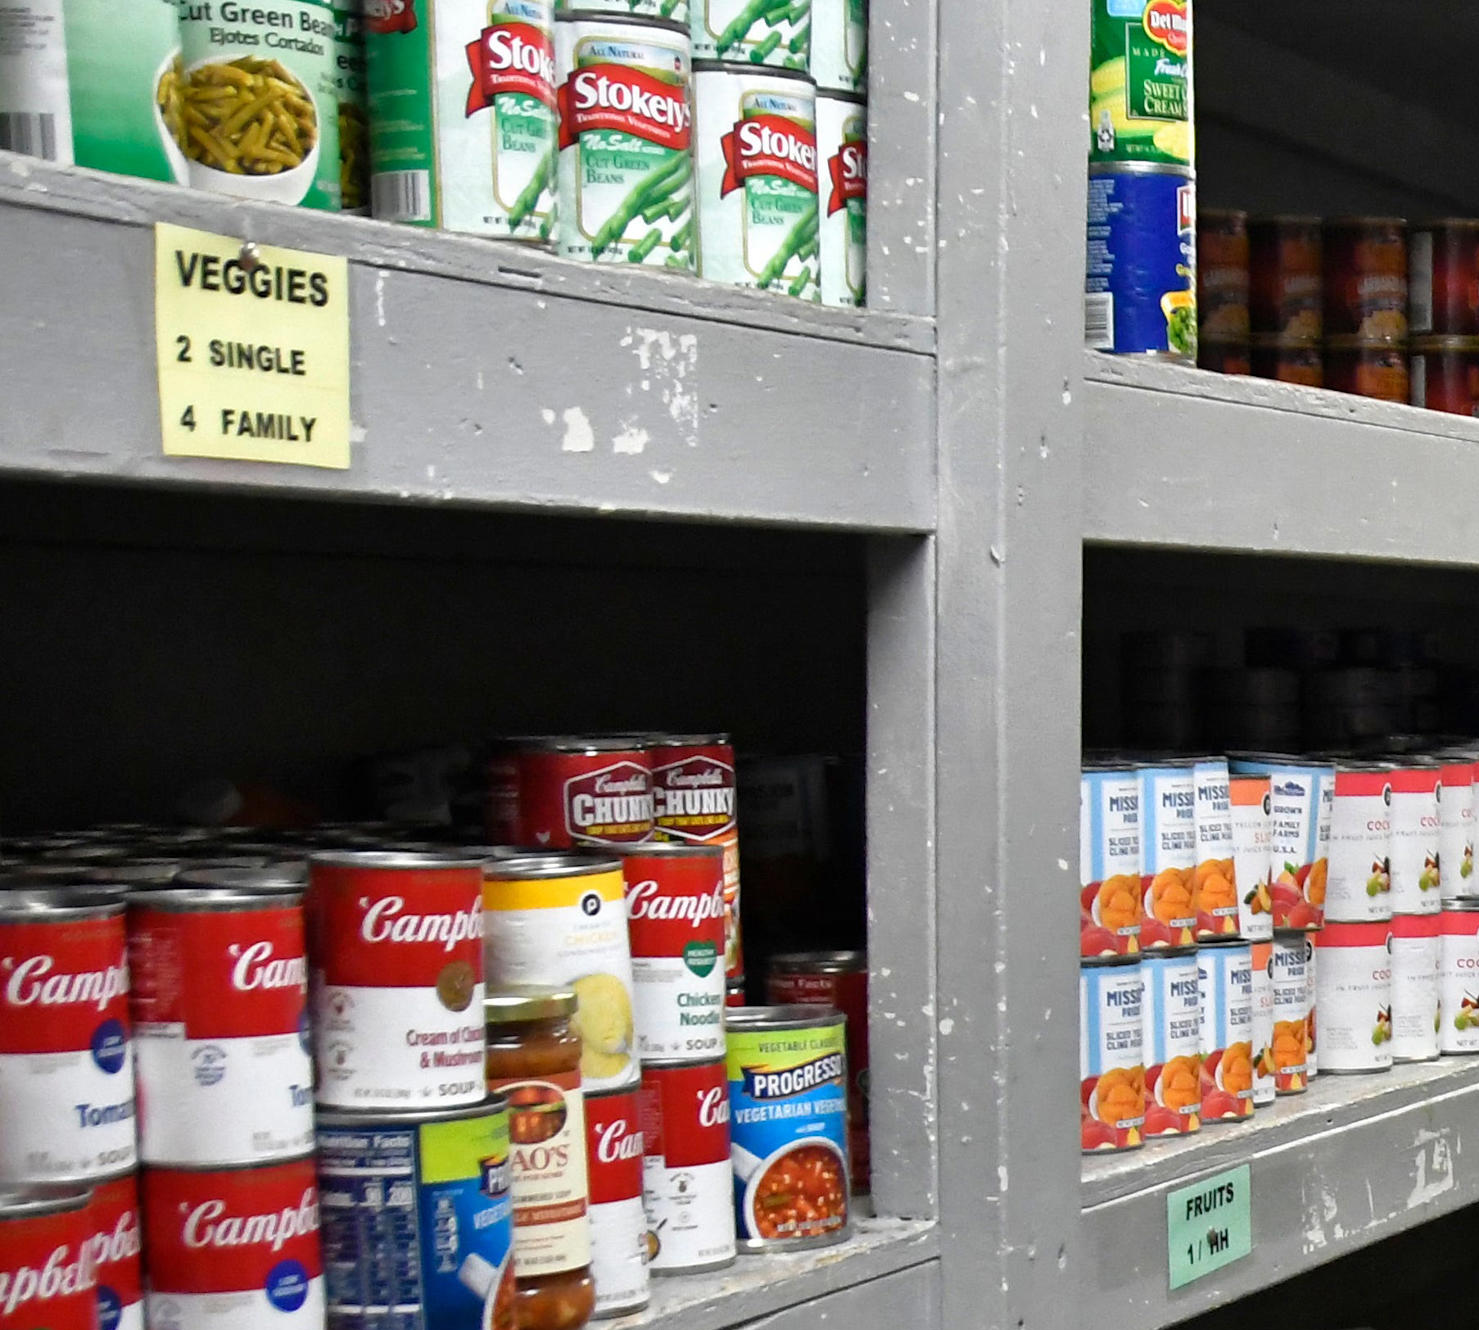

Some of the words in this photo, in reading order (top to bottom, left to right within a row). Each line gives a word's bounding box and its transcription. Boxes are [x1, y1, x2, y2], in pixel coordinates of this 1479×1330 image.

[220, 1, 293, 30] Green
[209, 27, 261, 46] Ejotes
[264, 32, 325, 56] Cortados
[1144, 79, 1180, 100] SWEET
[1144, 96, 1181, 117] CREAM
[583, 133, 608, 151] No
[609, 134, 642, 152] Salt
[586, 154, 611, 170] CUT
[612, 155, 650, 172] GREEN
[586, 169, 625, 186] BEANS
[175, 249, 329, 308] VEGGIES
[176, 334, 193, 363] 2
[208, 339, 306, 376] SINGLE
[180, 404, 196, 433] 4
[221, 408, 317, 442] FAMILY
[406, 1028, 448, 1047] Cream
[686, 1038, 718, 1051] SOUP
[420, 1050, 431, 1069] &
[438, 1080, 476, 1098] SOUP
[735, 1101, 812, 1125] VEGETARIAN
[1186, 1181, 1234, 1221] FRUITS
[1187, 1243, 1194, 1265] 1
